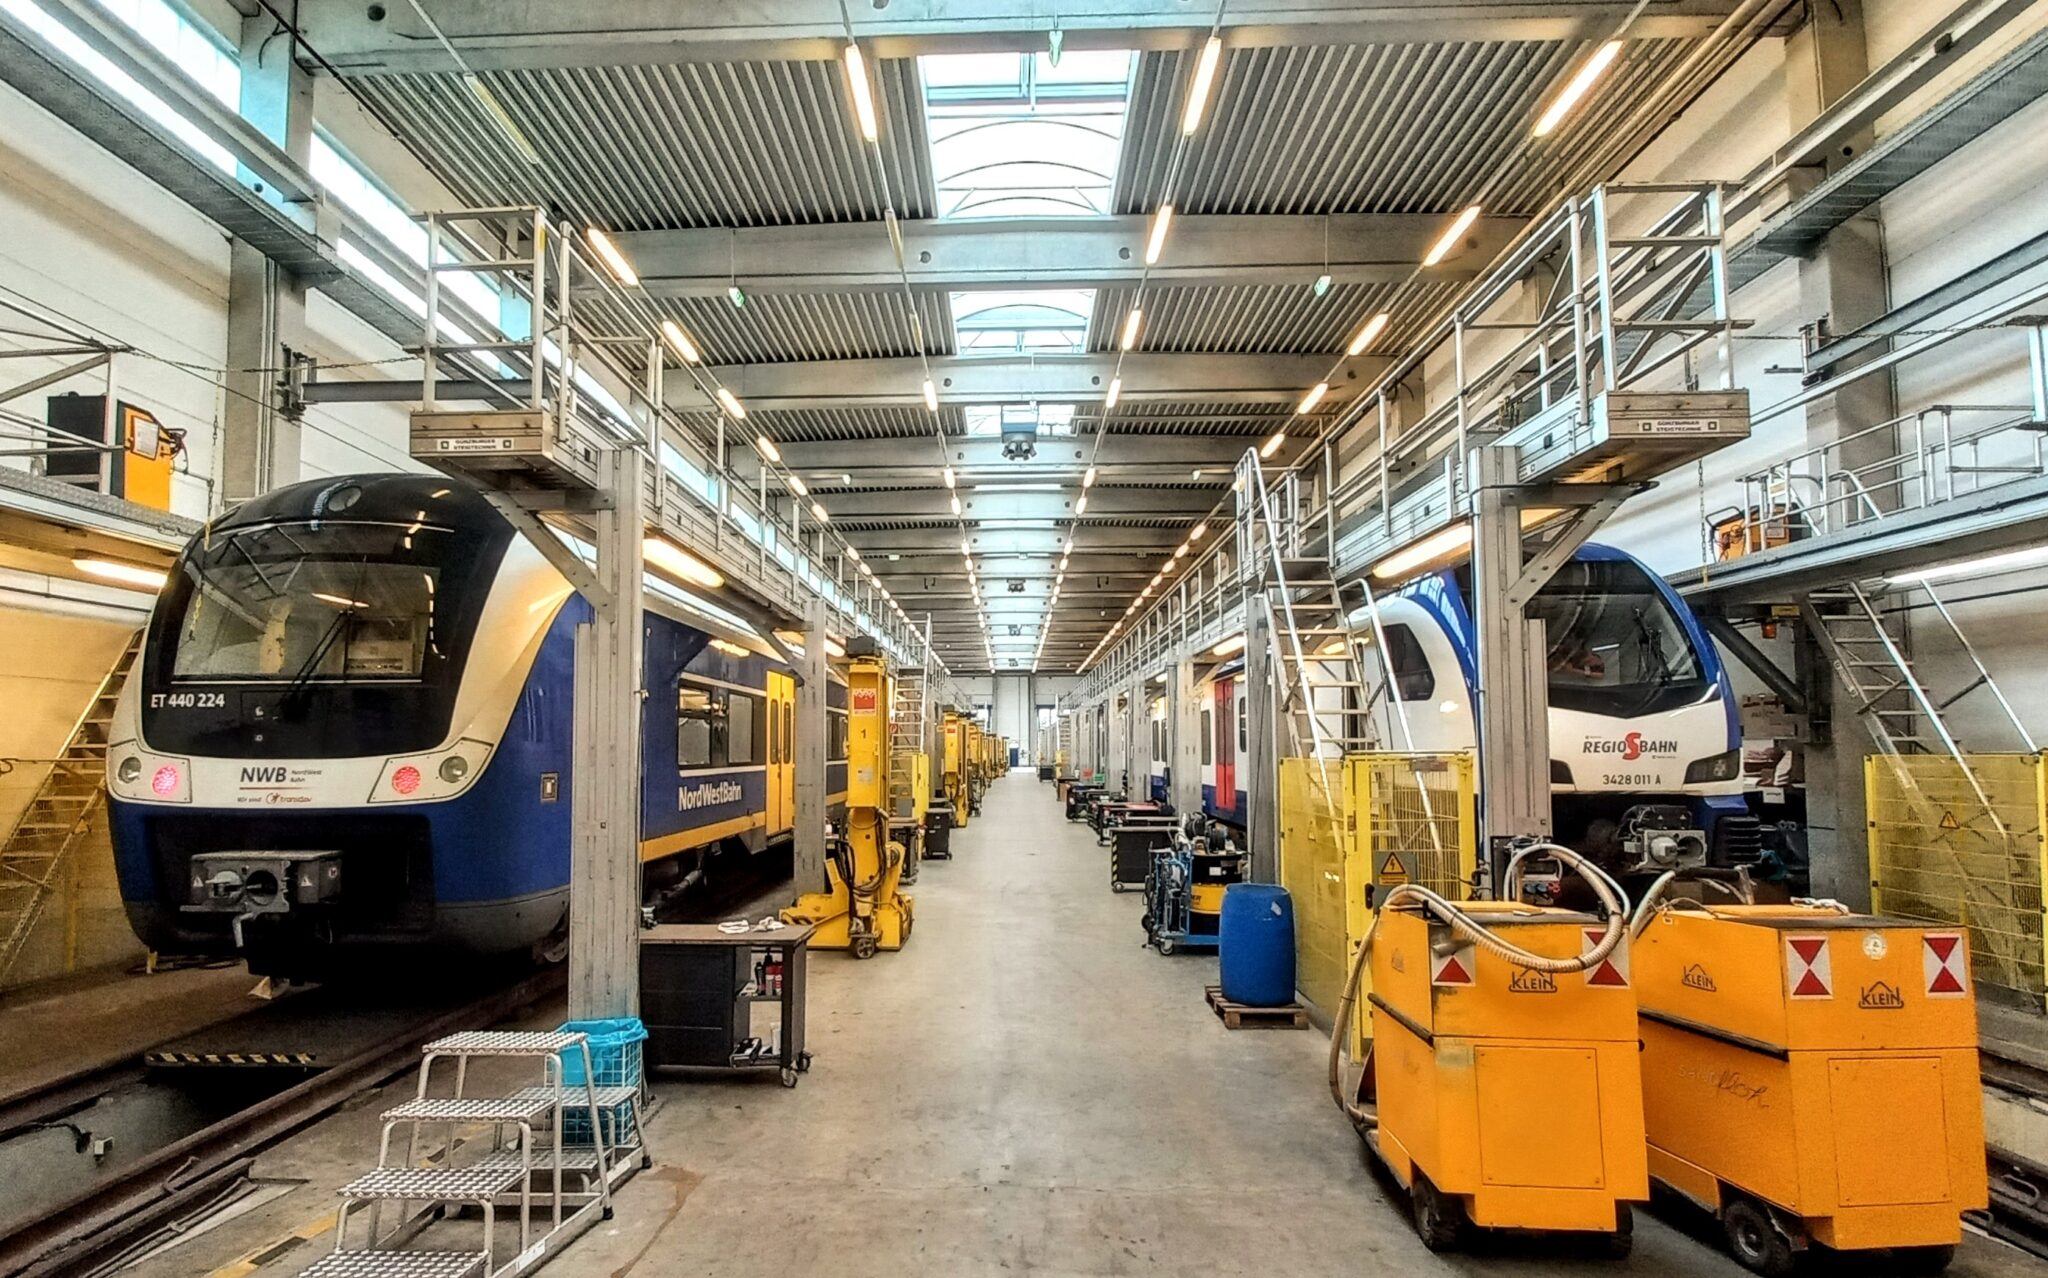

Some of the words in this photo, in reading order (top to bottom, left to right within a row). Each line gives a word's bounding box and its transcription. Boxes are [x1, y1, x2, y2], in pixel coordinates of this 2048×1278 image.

[151, 694, 166, 708] ET
[168, 694, 194, 708] 440
[197, 693, 225, 708] 224
[861, 729, 866, 738] 1
[240, 767, 287, 783] NWB
[1602, 774, 1632, 785] 3428
[1634, 774, 1651, 785] 011
[1655, 774, 1661, 785] A
[678, 781, 742, 811] NordWestBahn
[1511, 971, 1554, 990] KLEIN
[1683, 965, 1714, 989] KLEIN
[1861, 986, 1901, 1006] KLEIN
